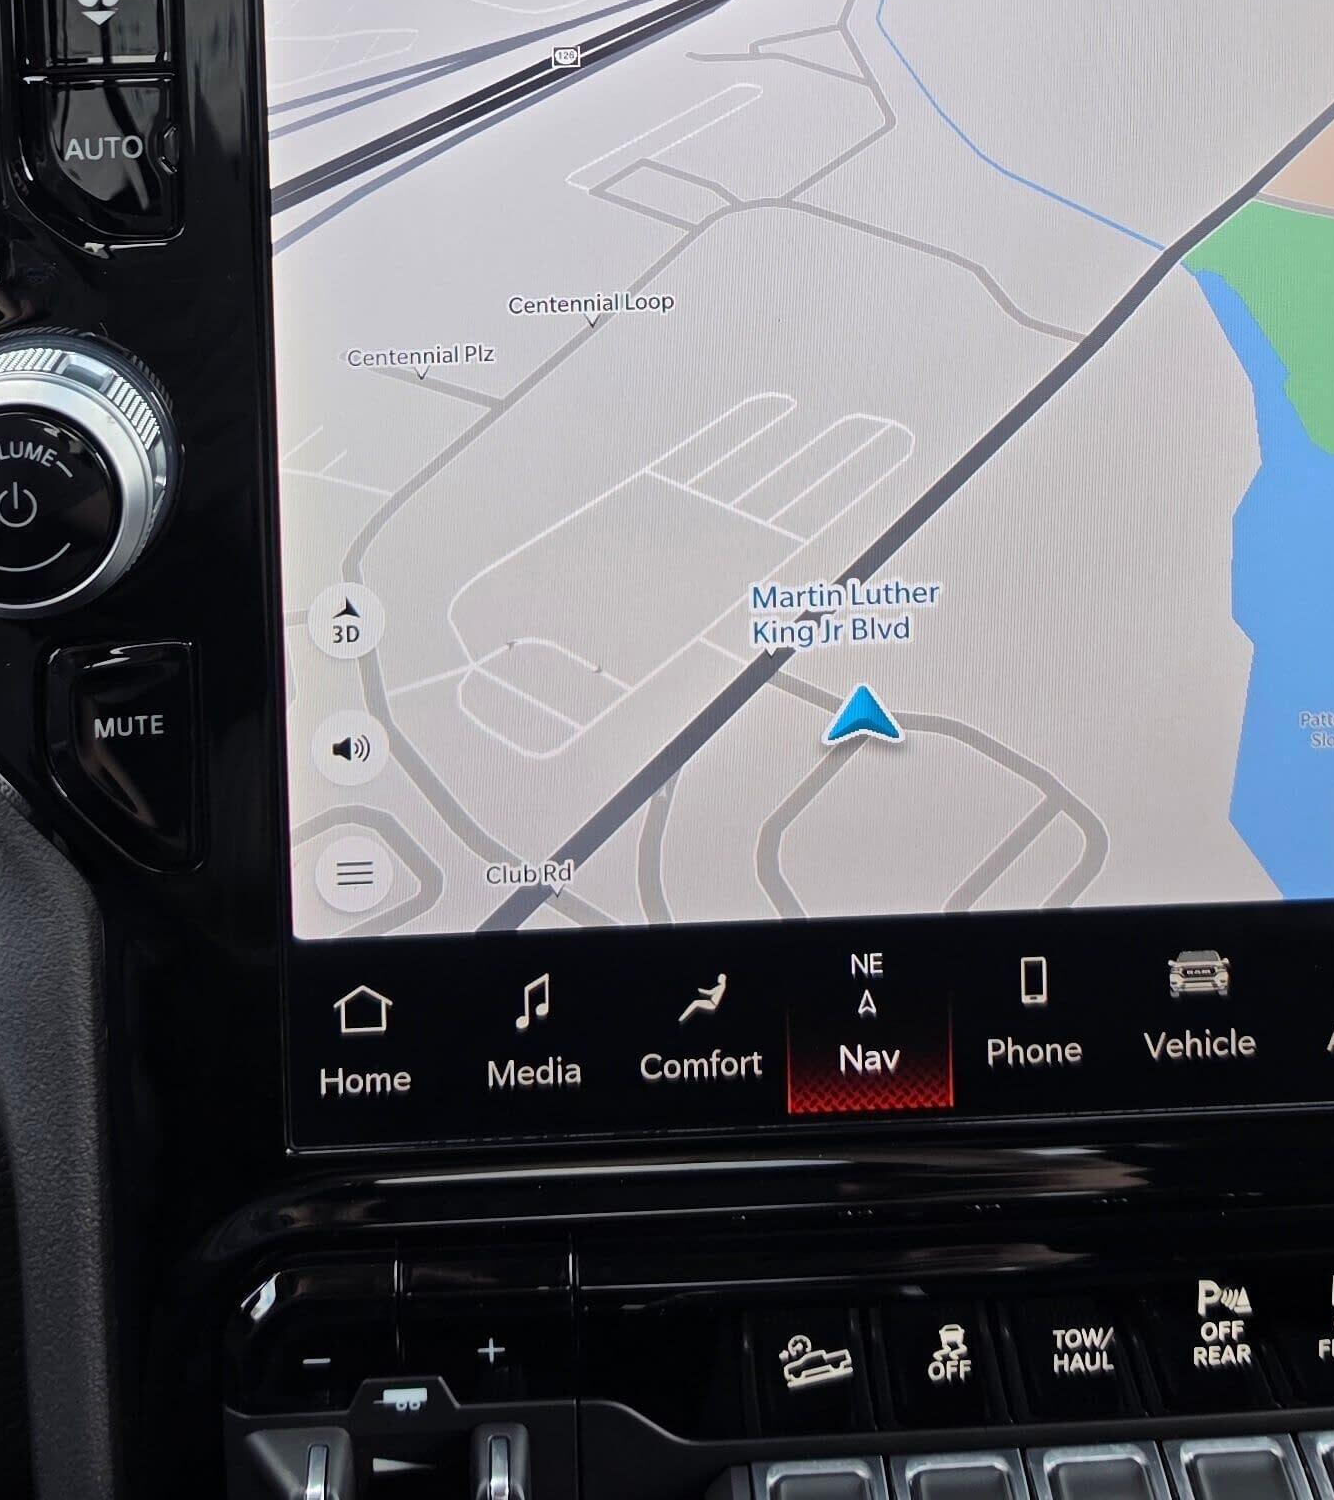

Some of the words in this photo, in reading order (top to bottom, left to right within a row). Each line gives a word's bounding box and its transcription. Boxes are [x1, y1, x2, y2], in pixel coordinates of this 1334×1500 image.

[65, 135, 144, 162] AUTO
[508, 295, 619, 315] Centennial
[626, 295, 675, 316] Loop
[347, 347, 459, 368] Centennial
[466, 345, 495, 364] Plz
[752, 585, 843, 609] Martin
[852, 583, 940, 606] Luther
[331, 625, 360, 644] 3D
[753, 620, 814, 649] King
[821, 620, 845, 645] Jr
[852, 618, 911, 642] Blvd
[94, 714, 165, 739] MUTE
[486, 864, 537, 886] Club
[543, 863, 573, 883] Rd
[851, 953, 884, 977] NE
[987, 1038, 1083, 1067] Phone
[1144, 1027, 1256, 1061] Vehicle
[640, 1050, 764, 1083] Comfort
[840, 1044, 901, 1074] Nav
[319, 1067, 412, 1098] Home
[487, 1056, 582, 1090] Media
[1052, 1325, 1115, 1351] TOW/
[1201, 1320, 1245, 1344] OFF
[1053, 1350, 1115, 1374] HAUL
[1193, 1342, 1251, 1367] REAR
[928, 1358, 971, 1383] OFF
